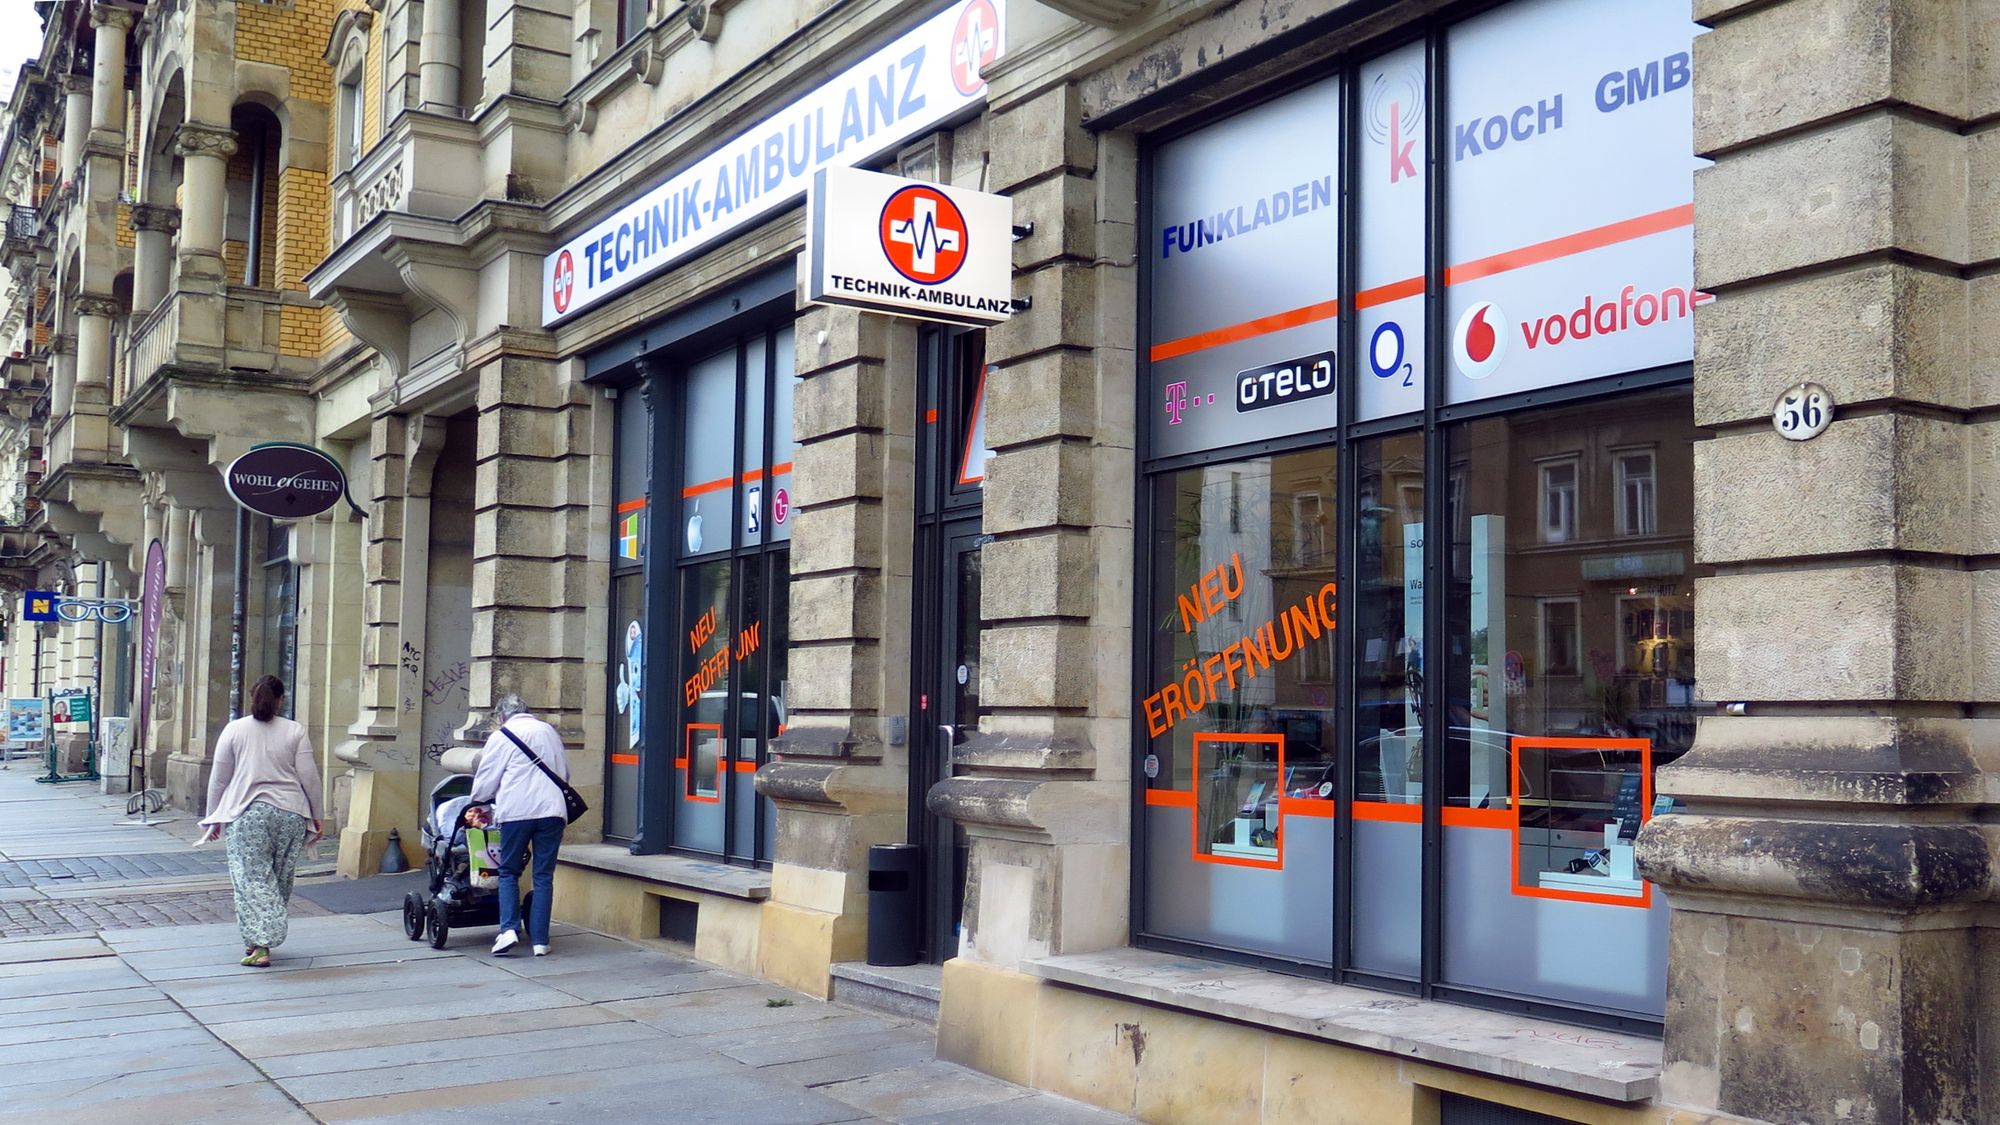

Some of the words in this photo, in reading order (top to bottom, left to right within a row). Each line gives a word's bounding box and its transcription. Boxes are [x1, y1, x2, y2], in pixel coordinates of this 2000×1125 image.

[1455, 93, 1563, 162] KOCH
[585, 45, 926, 289] TECHNIK-AMBULANZ
[1163, 176, 1331, 259] FUNKLADEN
[831, 275, 1010, 314] TECHNIK-AMBULANZ
[1782, 393, 1821, 431] 56
[690, 606, 716, 655] NEU
[1177, 552, 1244, 634] NEU
[1142, 583, 1338, 739] ERÖFFNUNG
